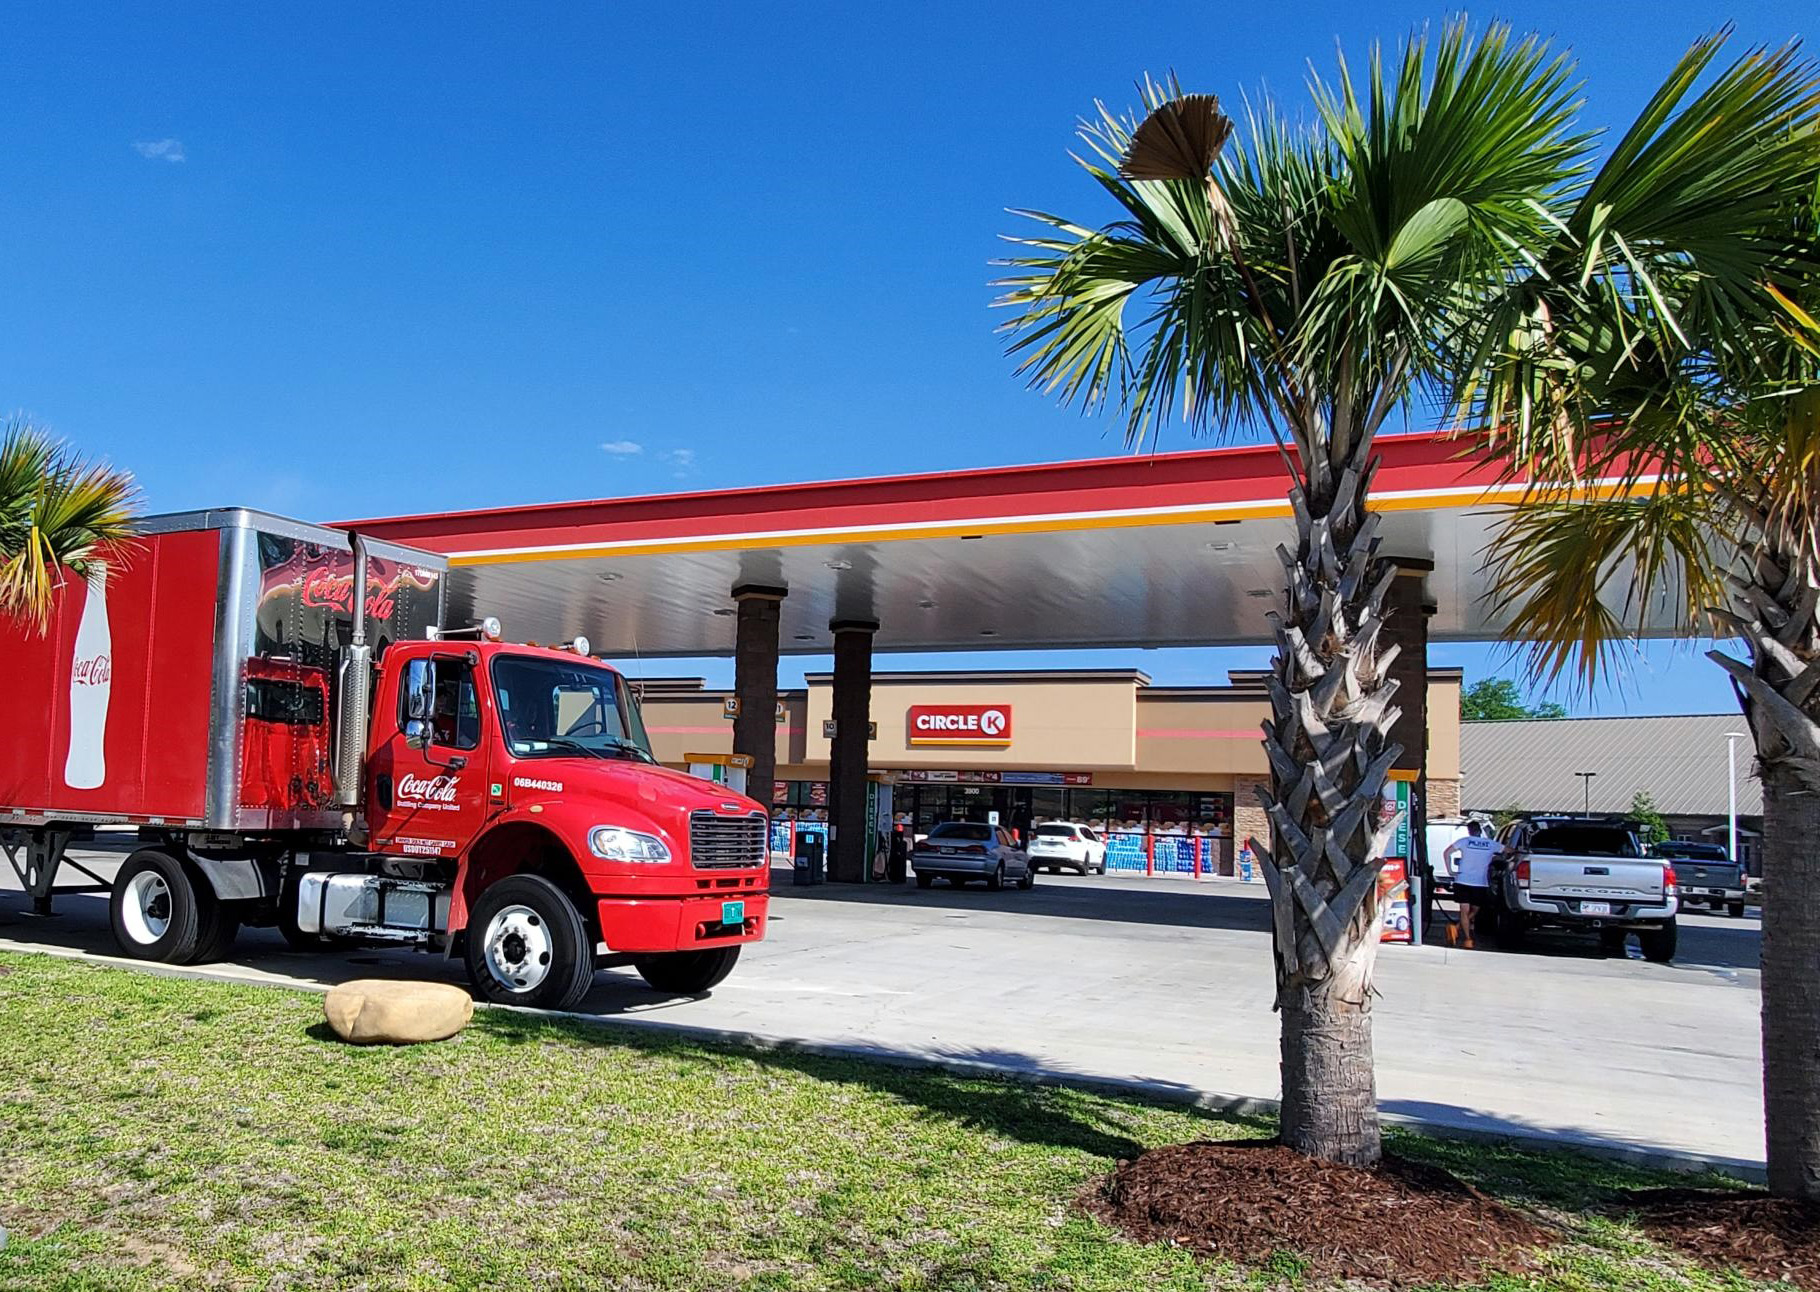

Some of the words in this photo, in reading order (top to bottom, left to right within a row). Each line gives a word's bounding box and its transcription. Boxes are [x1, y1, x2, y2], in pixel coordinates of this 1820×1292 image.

[302, 566, 400, 620] Cocaola
[73, 654, 110, 686] oca-Cola
[727, 701, 737, 709] 12
[916, 714, 978, 730] CIRCLE
[985, 713, 1004, 734] K
[1397, 800, 1407, 854] DESE
[1559, 887, 1637, 895] TACOMA
